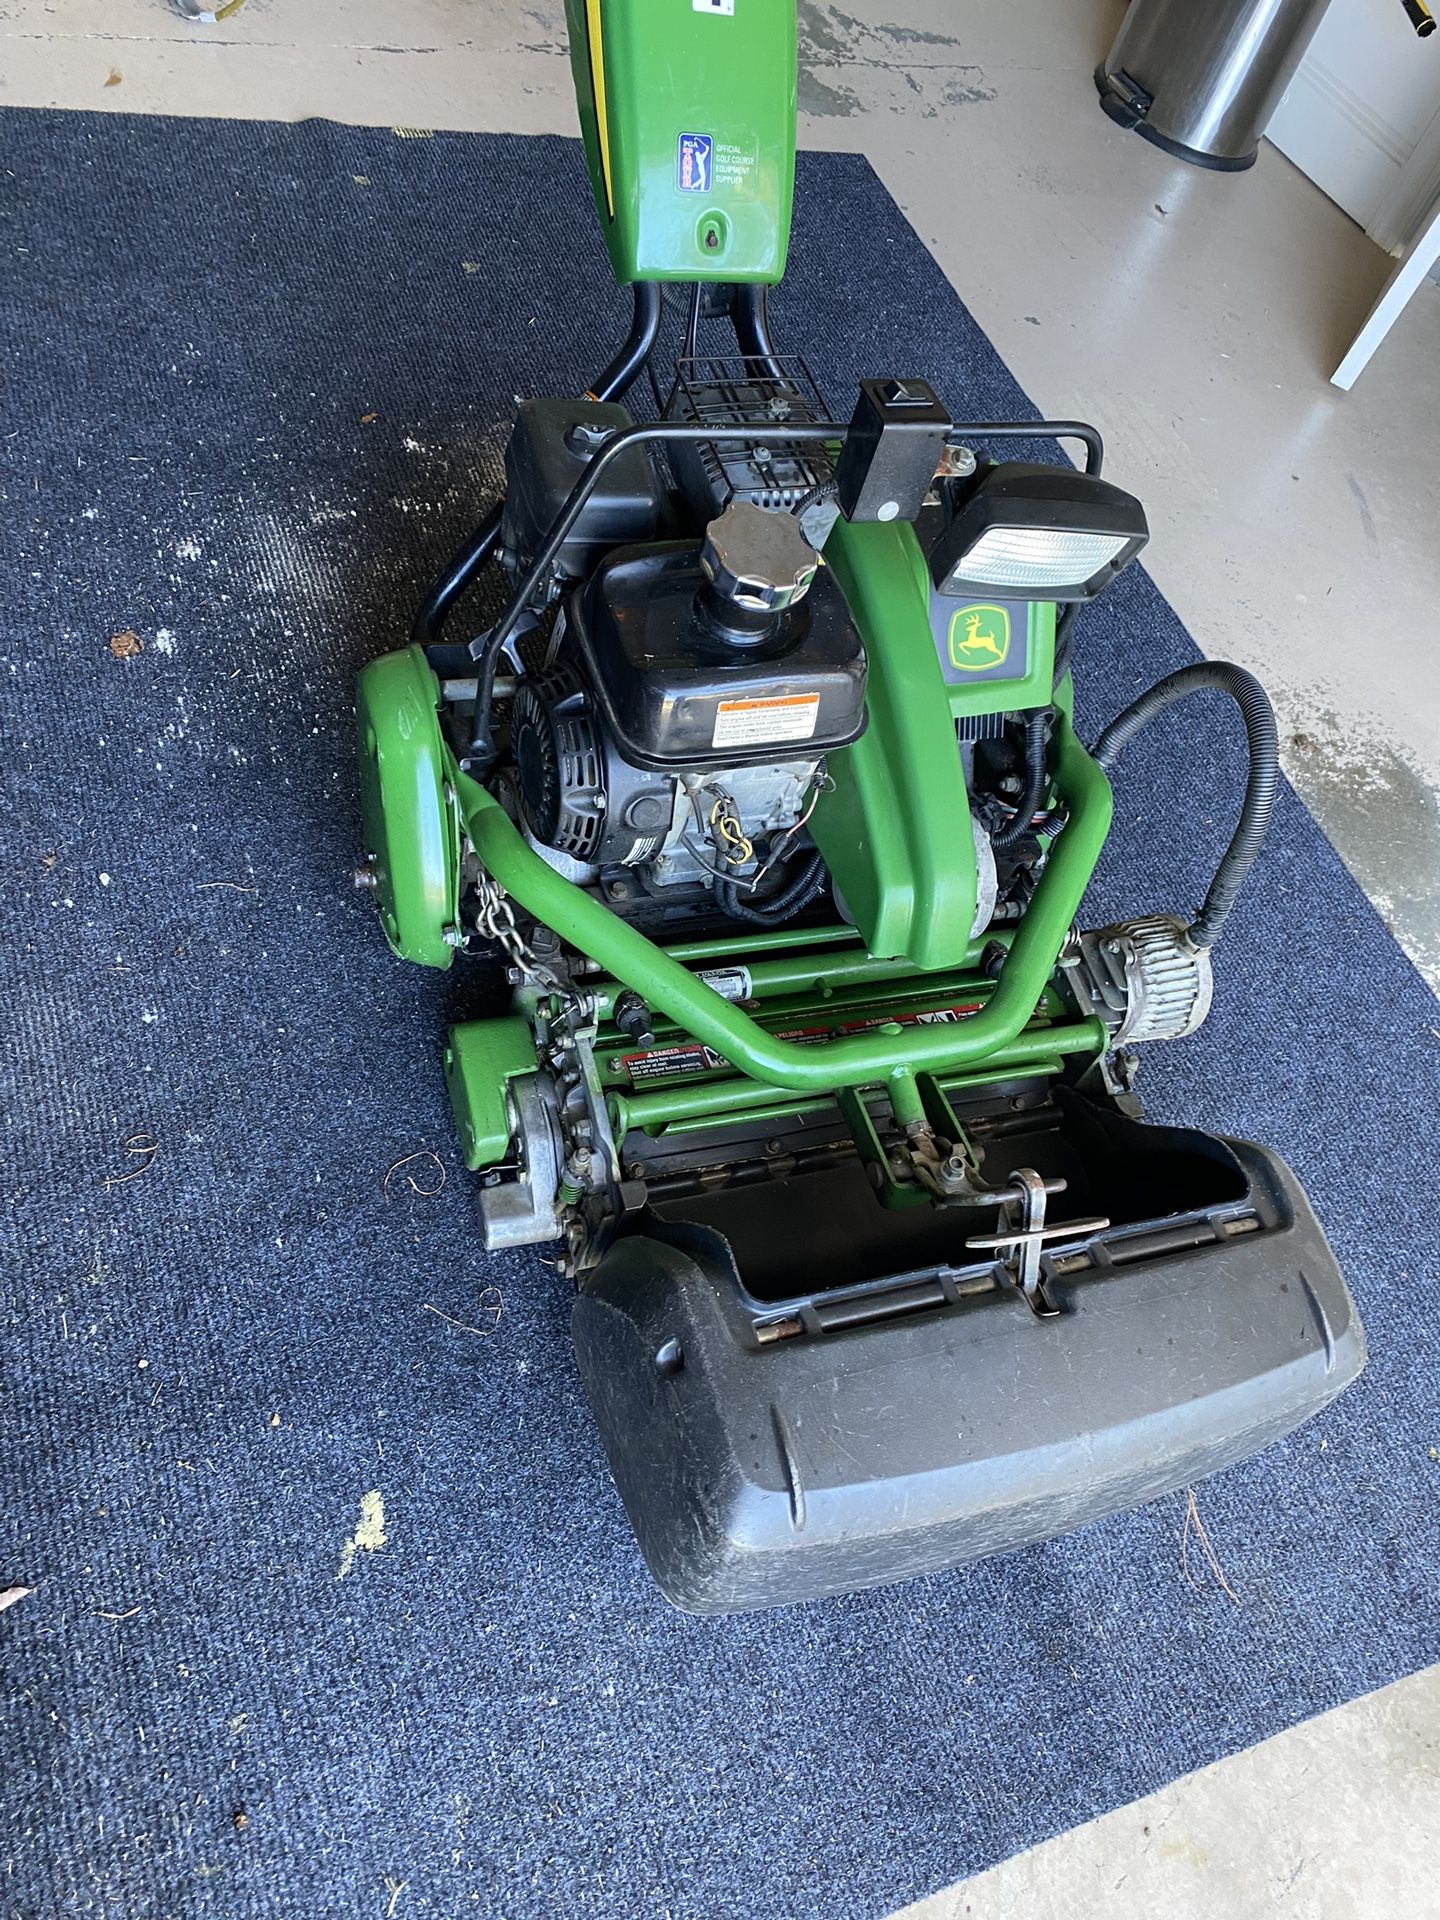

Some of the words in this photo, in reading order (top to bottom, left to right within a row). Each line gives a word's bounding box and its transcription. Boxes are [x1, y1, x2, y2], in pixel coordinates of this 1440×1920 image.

[683, 140, 698, 148] PGA
[716, 144, 741, 154] OFFICIAL
[716, 155, 730, 164] GOLF
[731, 156, 754, 165] COURSE
[682, 147, 693, 188] TOUR
[716, 165, 750, 175] EQUIPMENT
[716, 175, 743, 184] SUPPLIER
